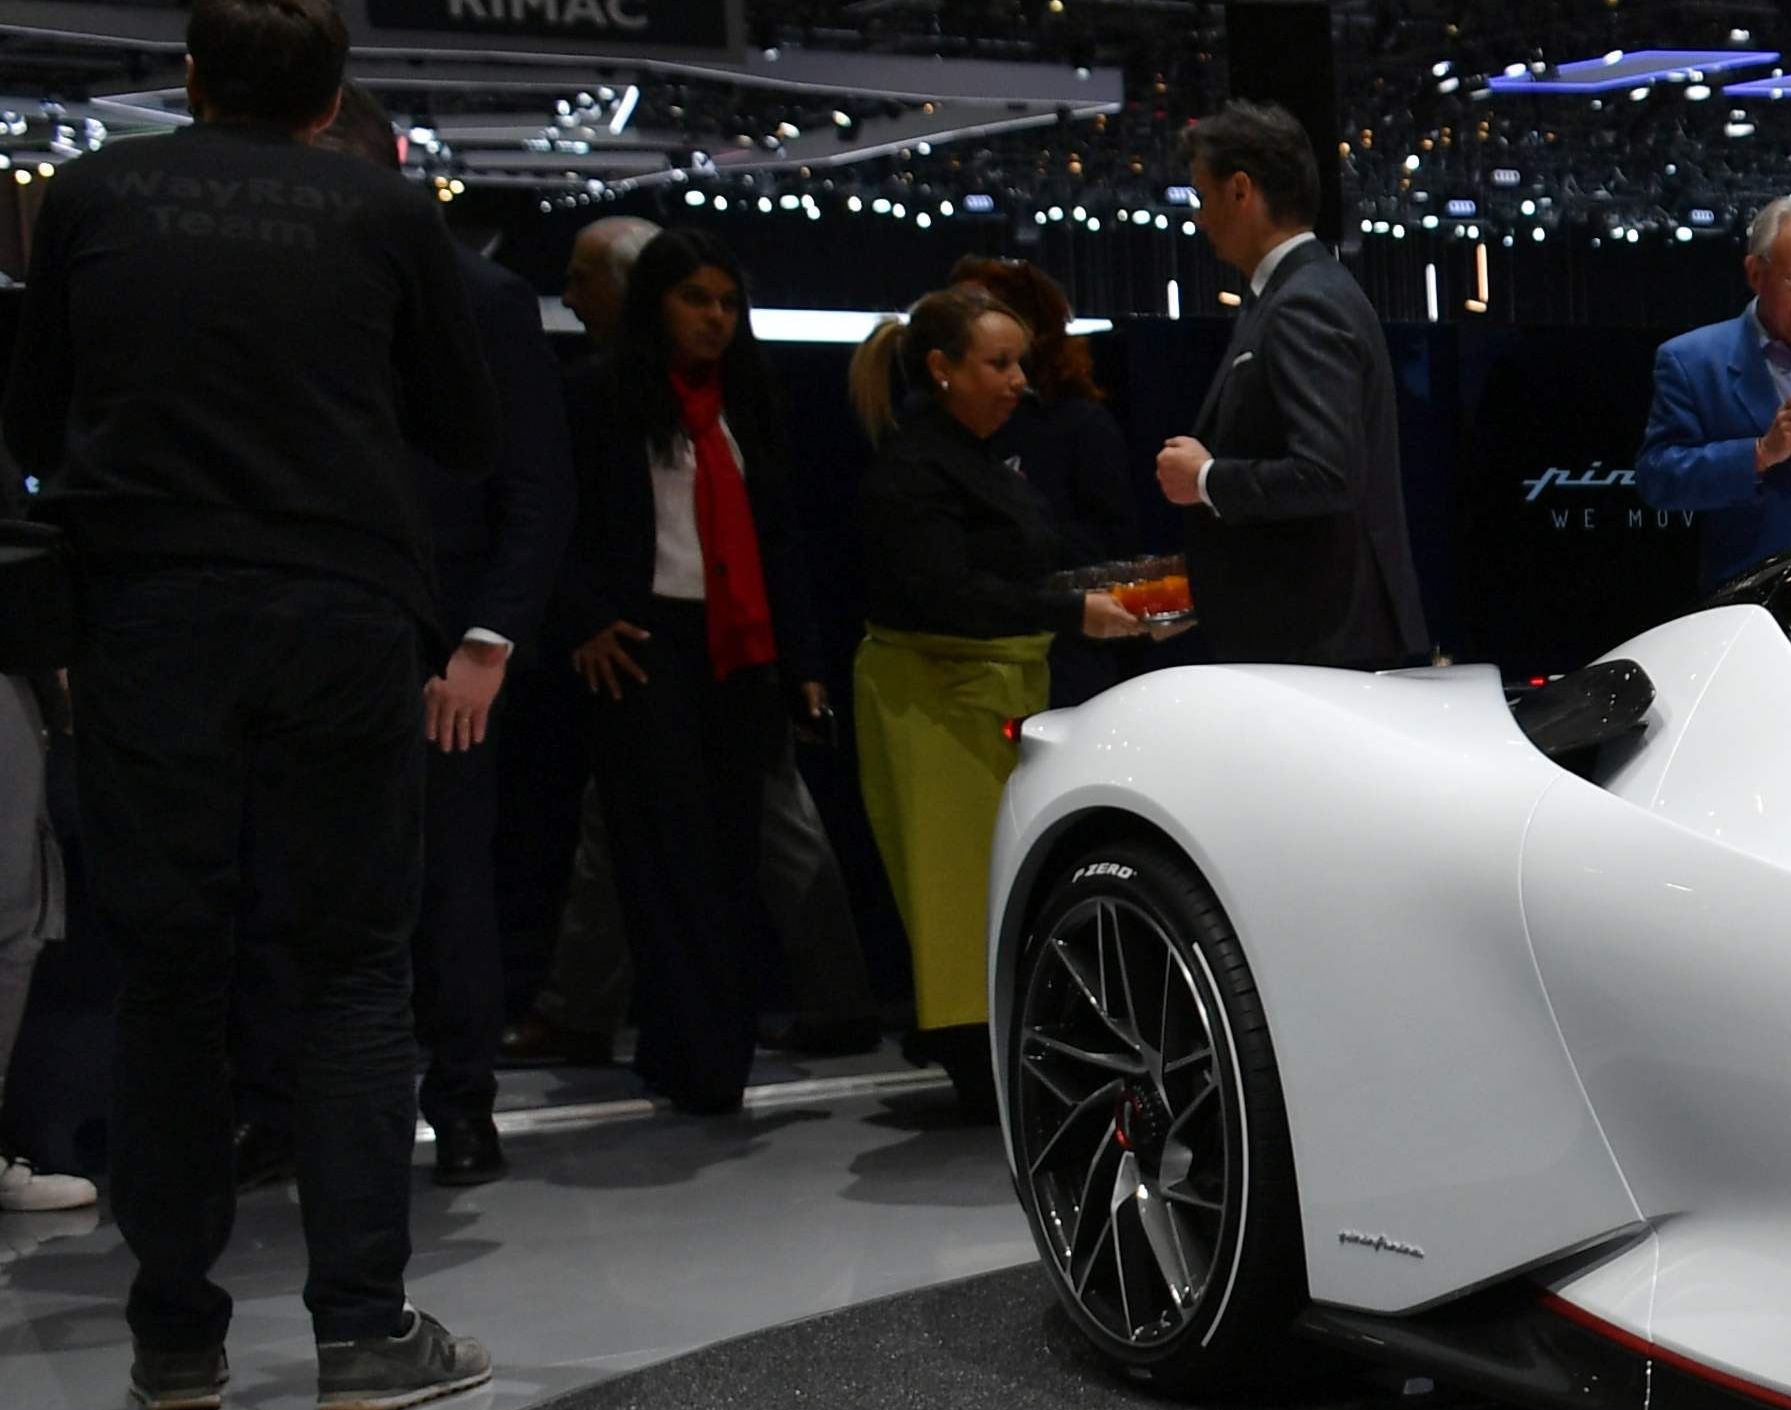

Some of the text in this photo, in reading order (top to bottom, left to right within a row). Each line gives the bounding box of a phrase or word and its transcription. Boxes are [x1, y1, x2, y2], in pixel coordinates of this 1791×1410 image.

[146, 205, 316, 250] Team
[1551, 508, 1694, 529] WE MOV
[1083, 861, 1135, 880] ZERO
